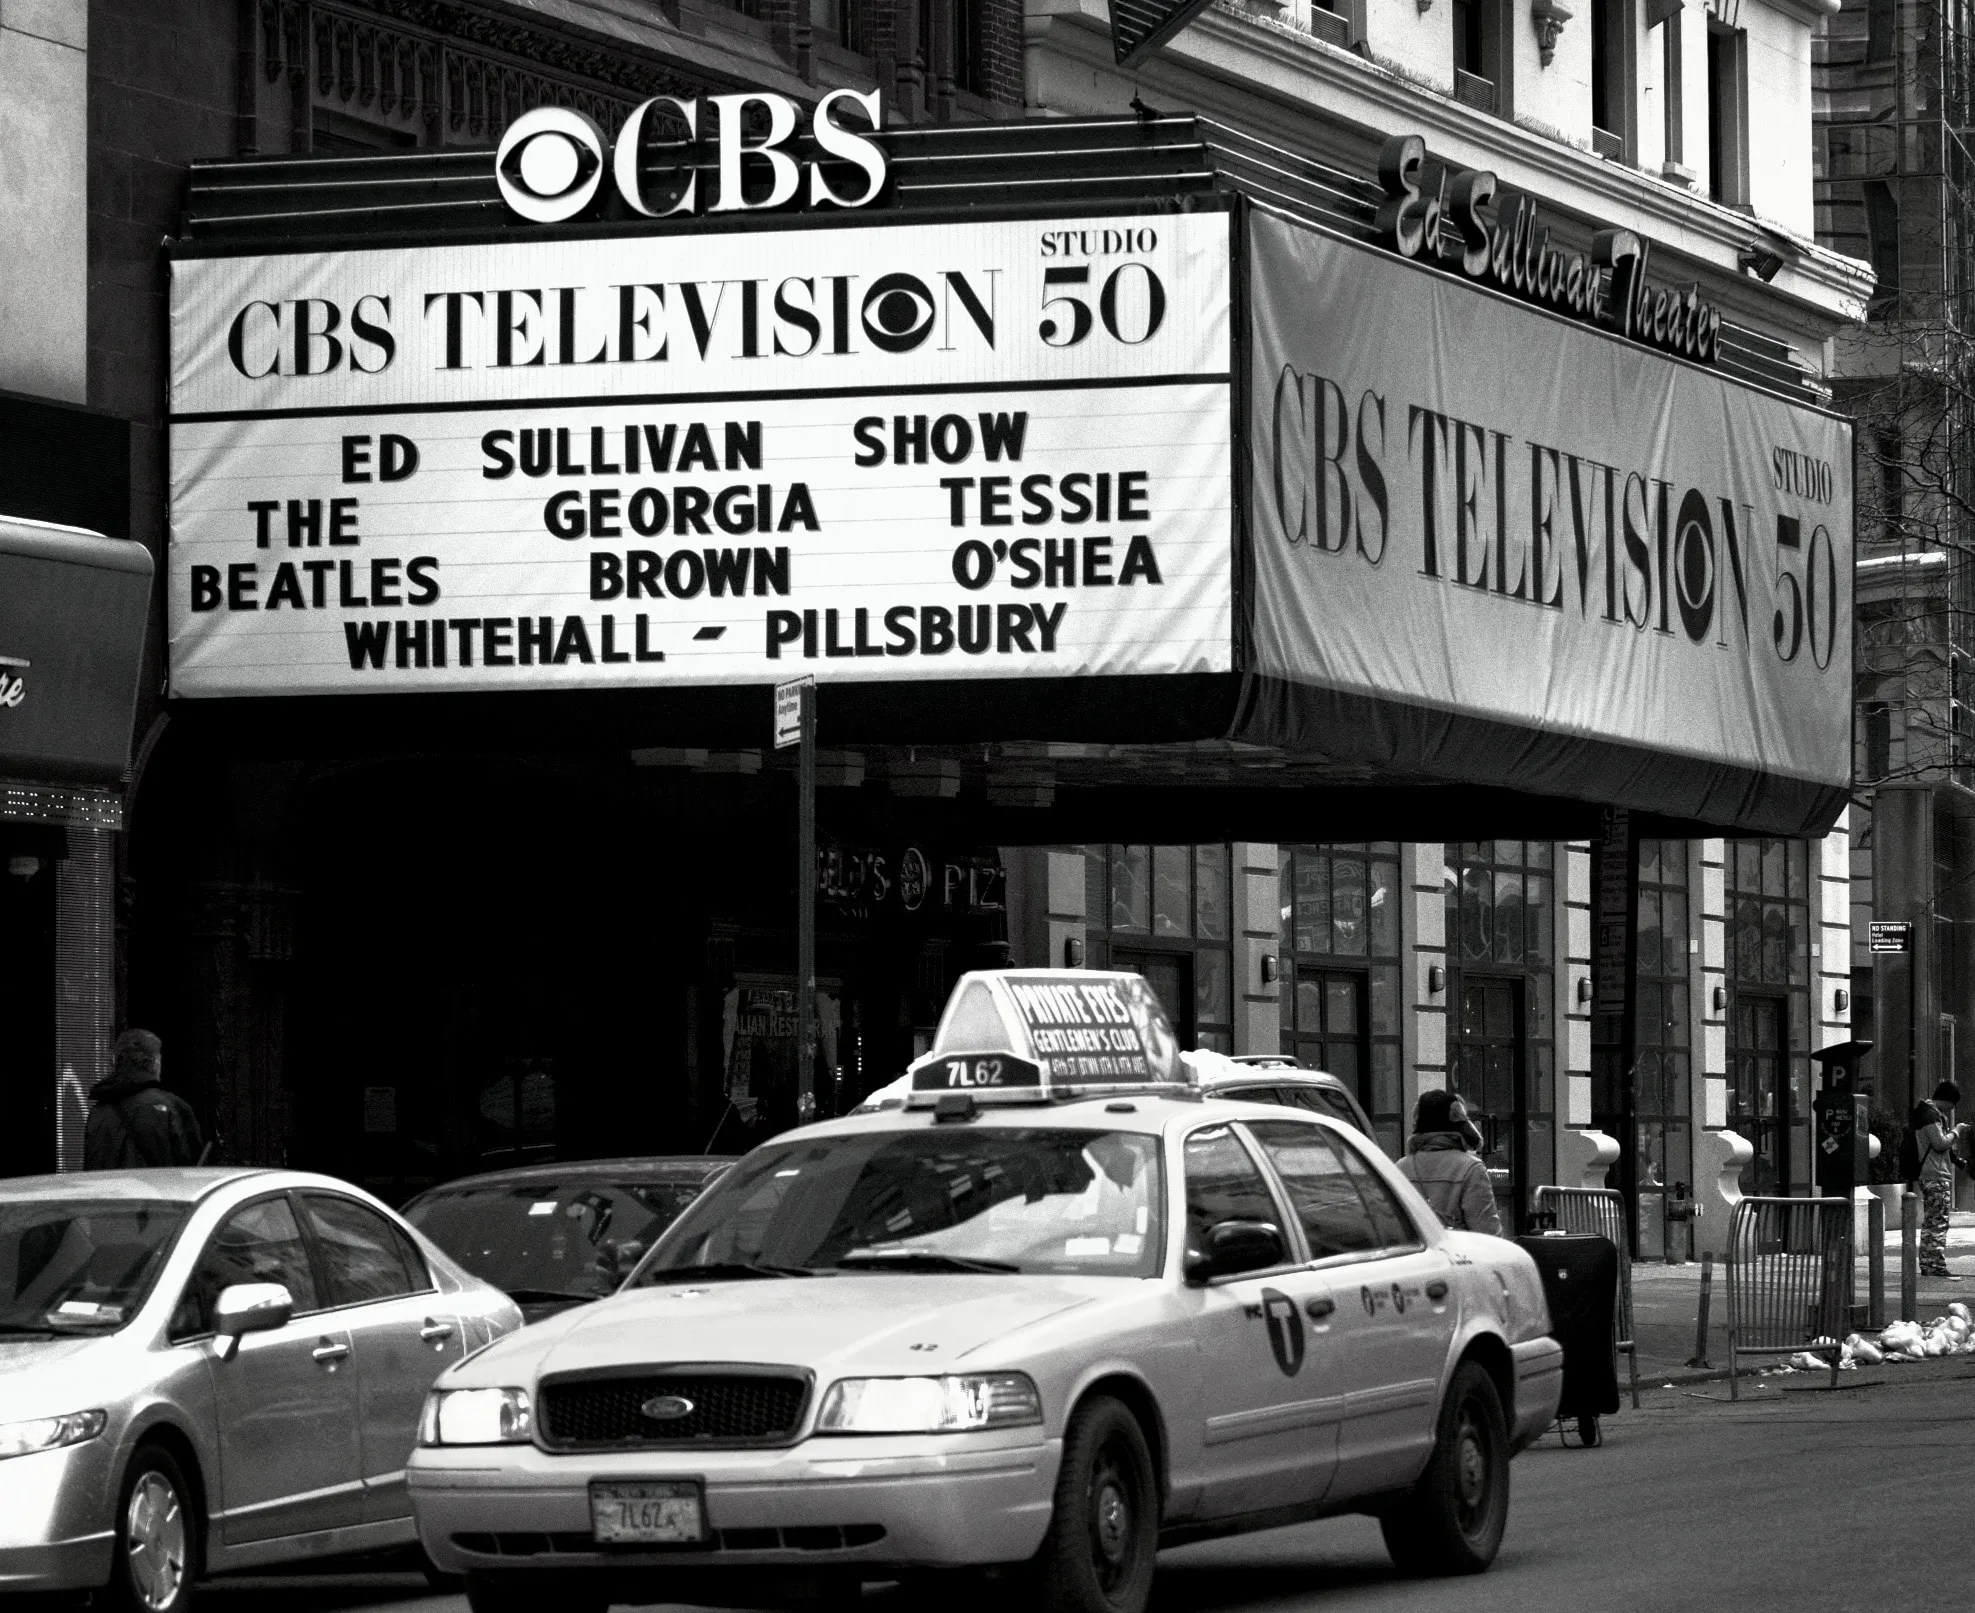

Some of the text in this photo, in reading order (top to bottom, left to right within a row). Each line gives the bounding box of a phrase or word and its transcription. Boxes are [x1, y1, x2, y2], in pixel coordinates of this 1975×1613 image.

[613, 88, 888, 218] CBS
[1040, 228, 1158, 256] STUDIO
[1388, 134, 1722, 362] Ed Sullivan Theater
[227, 262, 1167, 379] CBS TELEVISION 50
[341, 411, 1029, 483] ED SULLIVAN SHOW
[1772, 444, 1833, 505] STUDIO
[247, 498, 360, 549] THE
[543, 482, 822, 541] GEORGIA
[940, 470, 1151, 527] TESSIE
[1272, 363, 1838, 671] CBS TELEVISION 50
[190, 556, 441, 613] BEATLES
[589, 546, 791, 601] BROWN
[952, 535, 1164, 591] O'SHEA
[343, 612, 666, 670] WHITEHALL
[765, 602, 1068, 660] PILLSBURY
[943, 863, 1006, 909] PIZ
[769, 1010, 801, 1038] REST
[1011, 984, 1130, 1024] PRIVATE EYES
[1033, 1028, 1140, 1053] GENTLEMEN'S CLUB
[945, 1060, 1004, 1087] 7L62
[1831, 1065, 1846, 1087] P
[909, 1342, 938, 1353] 42
